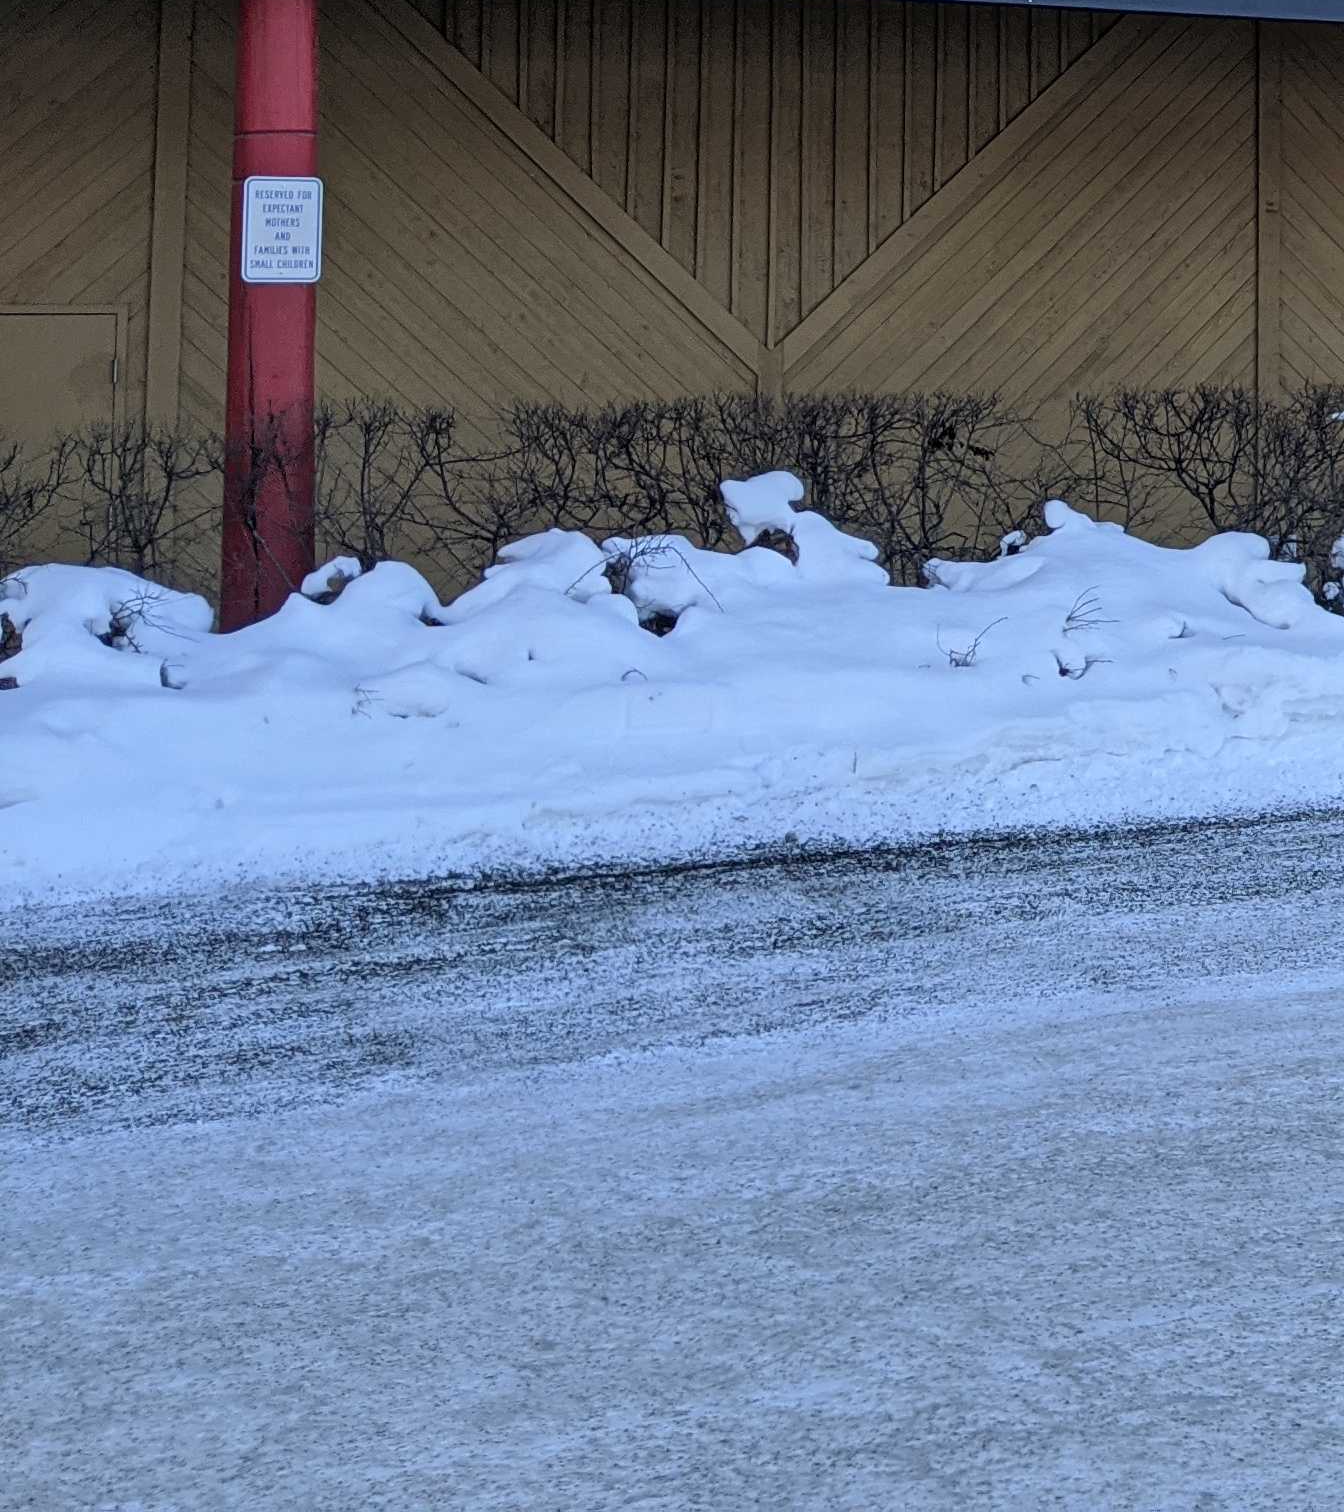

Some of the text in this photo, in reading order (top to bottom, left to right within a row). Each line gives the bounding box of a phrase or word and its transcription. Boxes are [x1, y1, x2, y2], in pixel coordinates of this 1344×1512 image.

[255, 190, 312, 200] RESERVED FOR
[262, 204, 304, 214] EXPECTANT
[265, 218, 300, 228] MOTHERS
[275, 231, 291, 241] AND
[254, 245, 310, 255] FAMILIES WITH
[250, 259, 314, 269] SMALL CHILDREN
